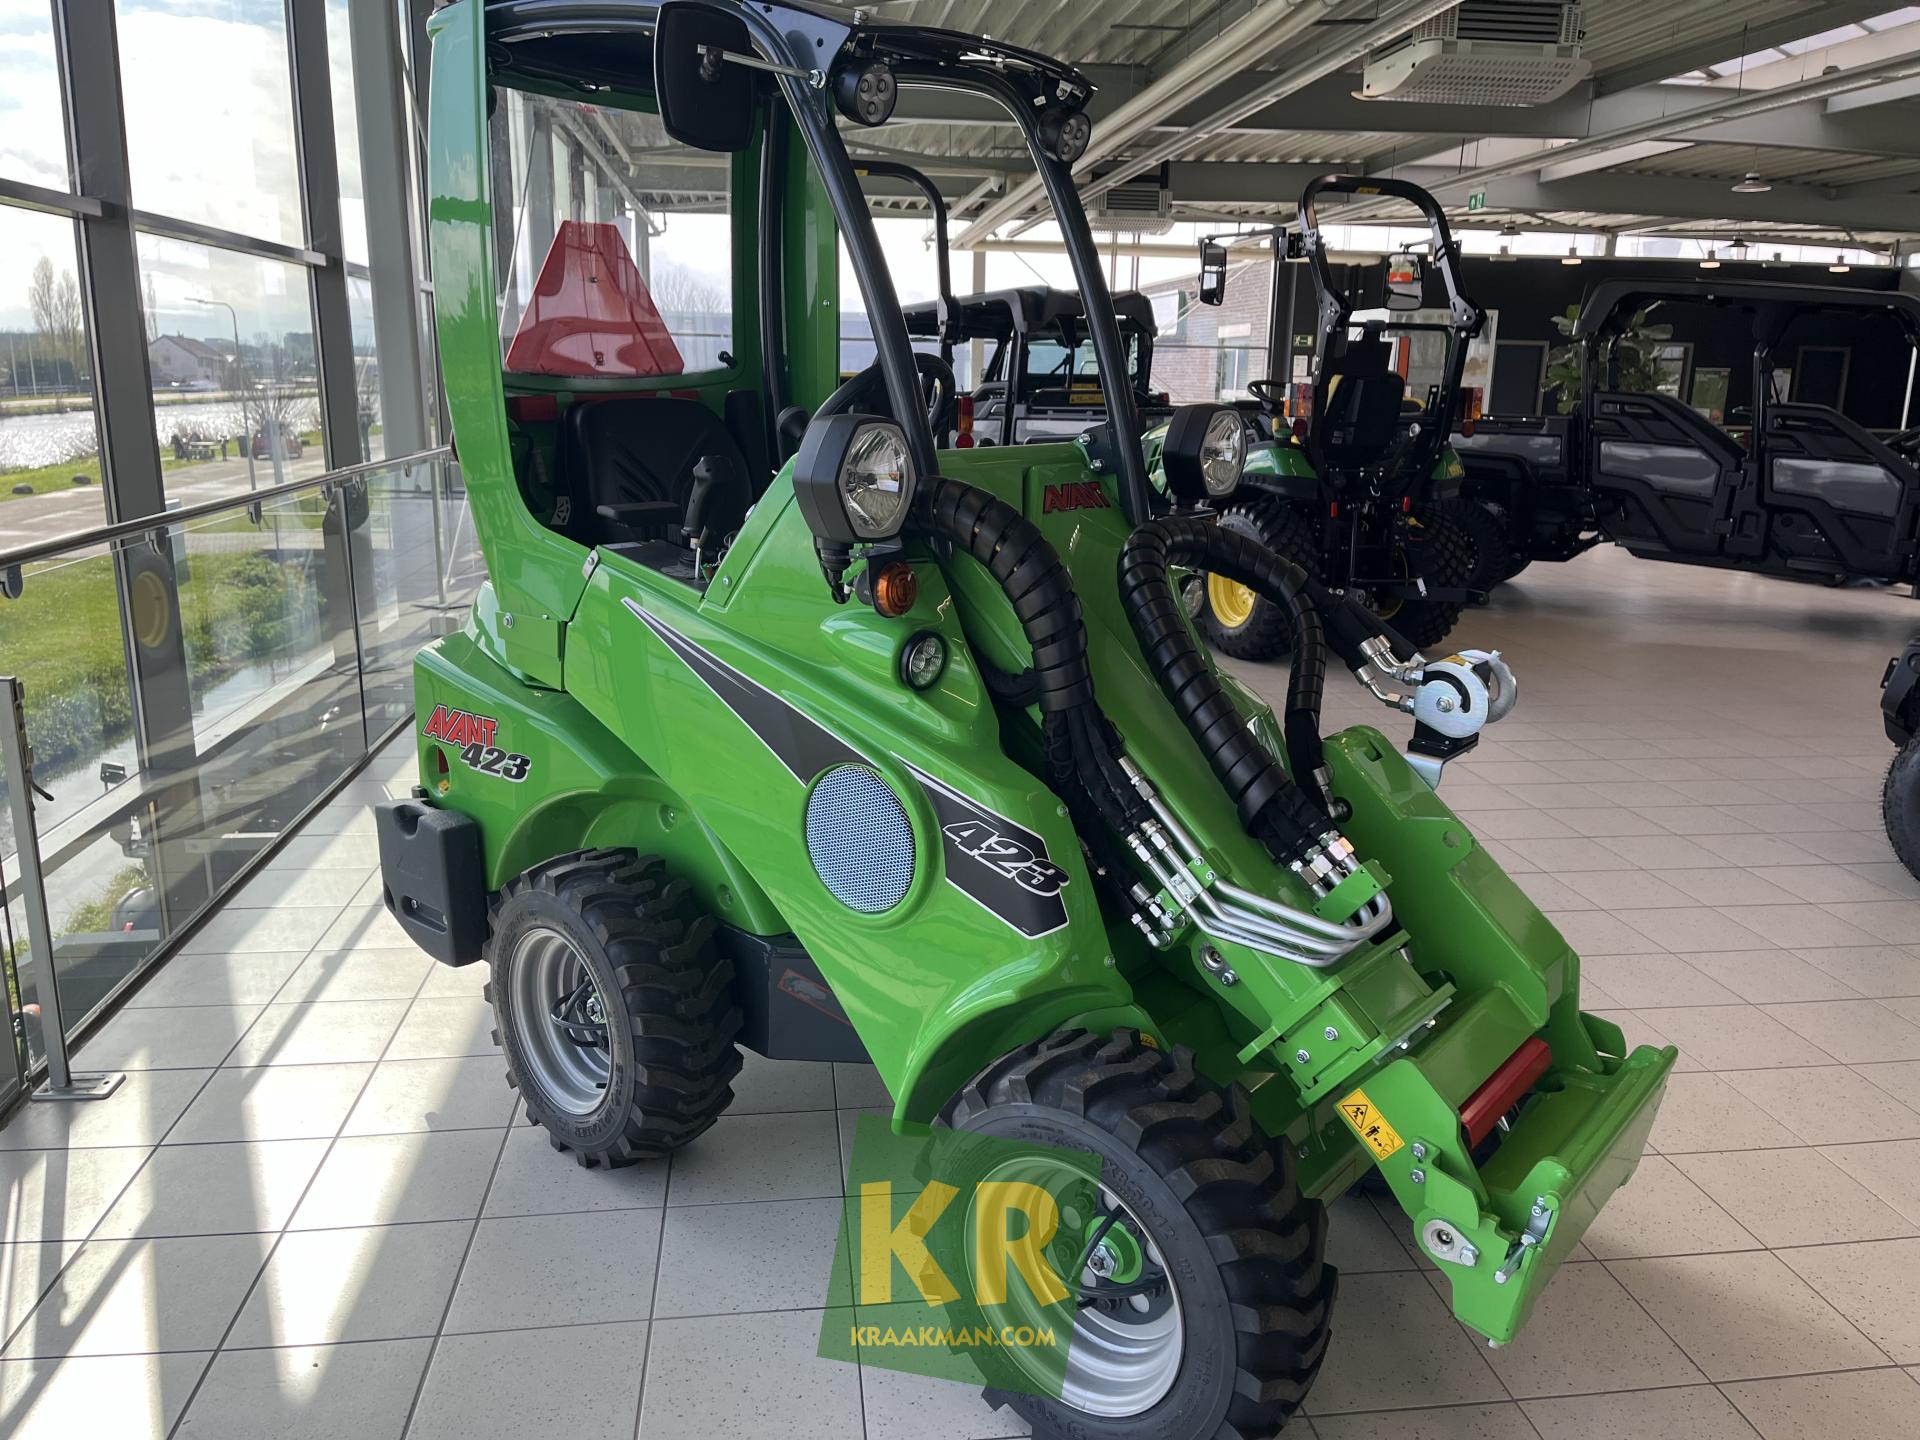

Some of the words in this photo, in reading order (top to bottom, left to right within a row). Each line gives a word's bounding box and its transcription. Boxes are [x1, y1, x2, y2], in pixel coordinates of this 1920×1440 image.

[422, 704, 498, 749] AVANT
[460, 742, 532, 783] 423
[943, 820, 1071, 897] 423
